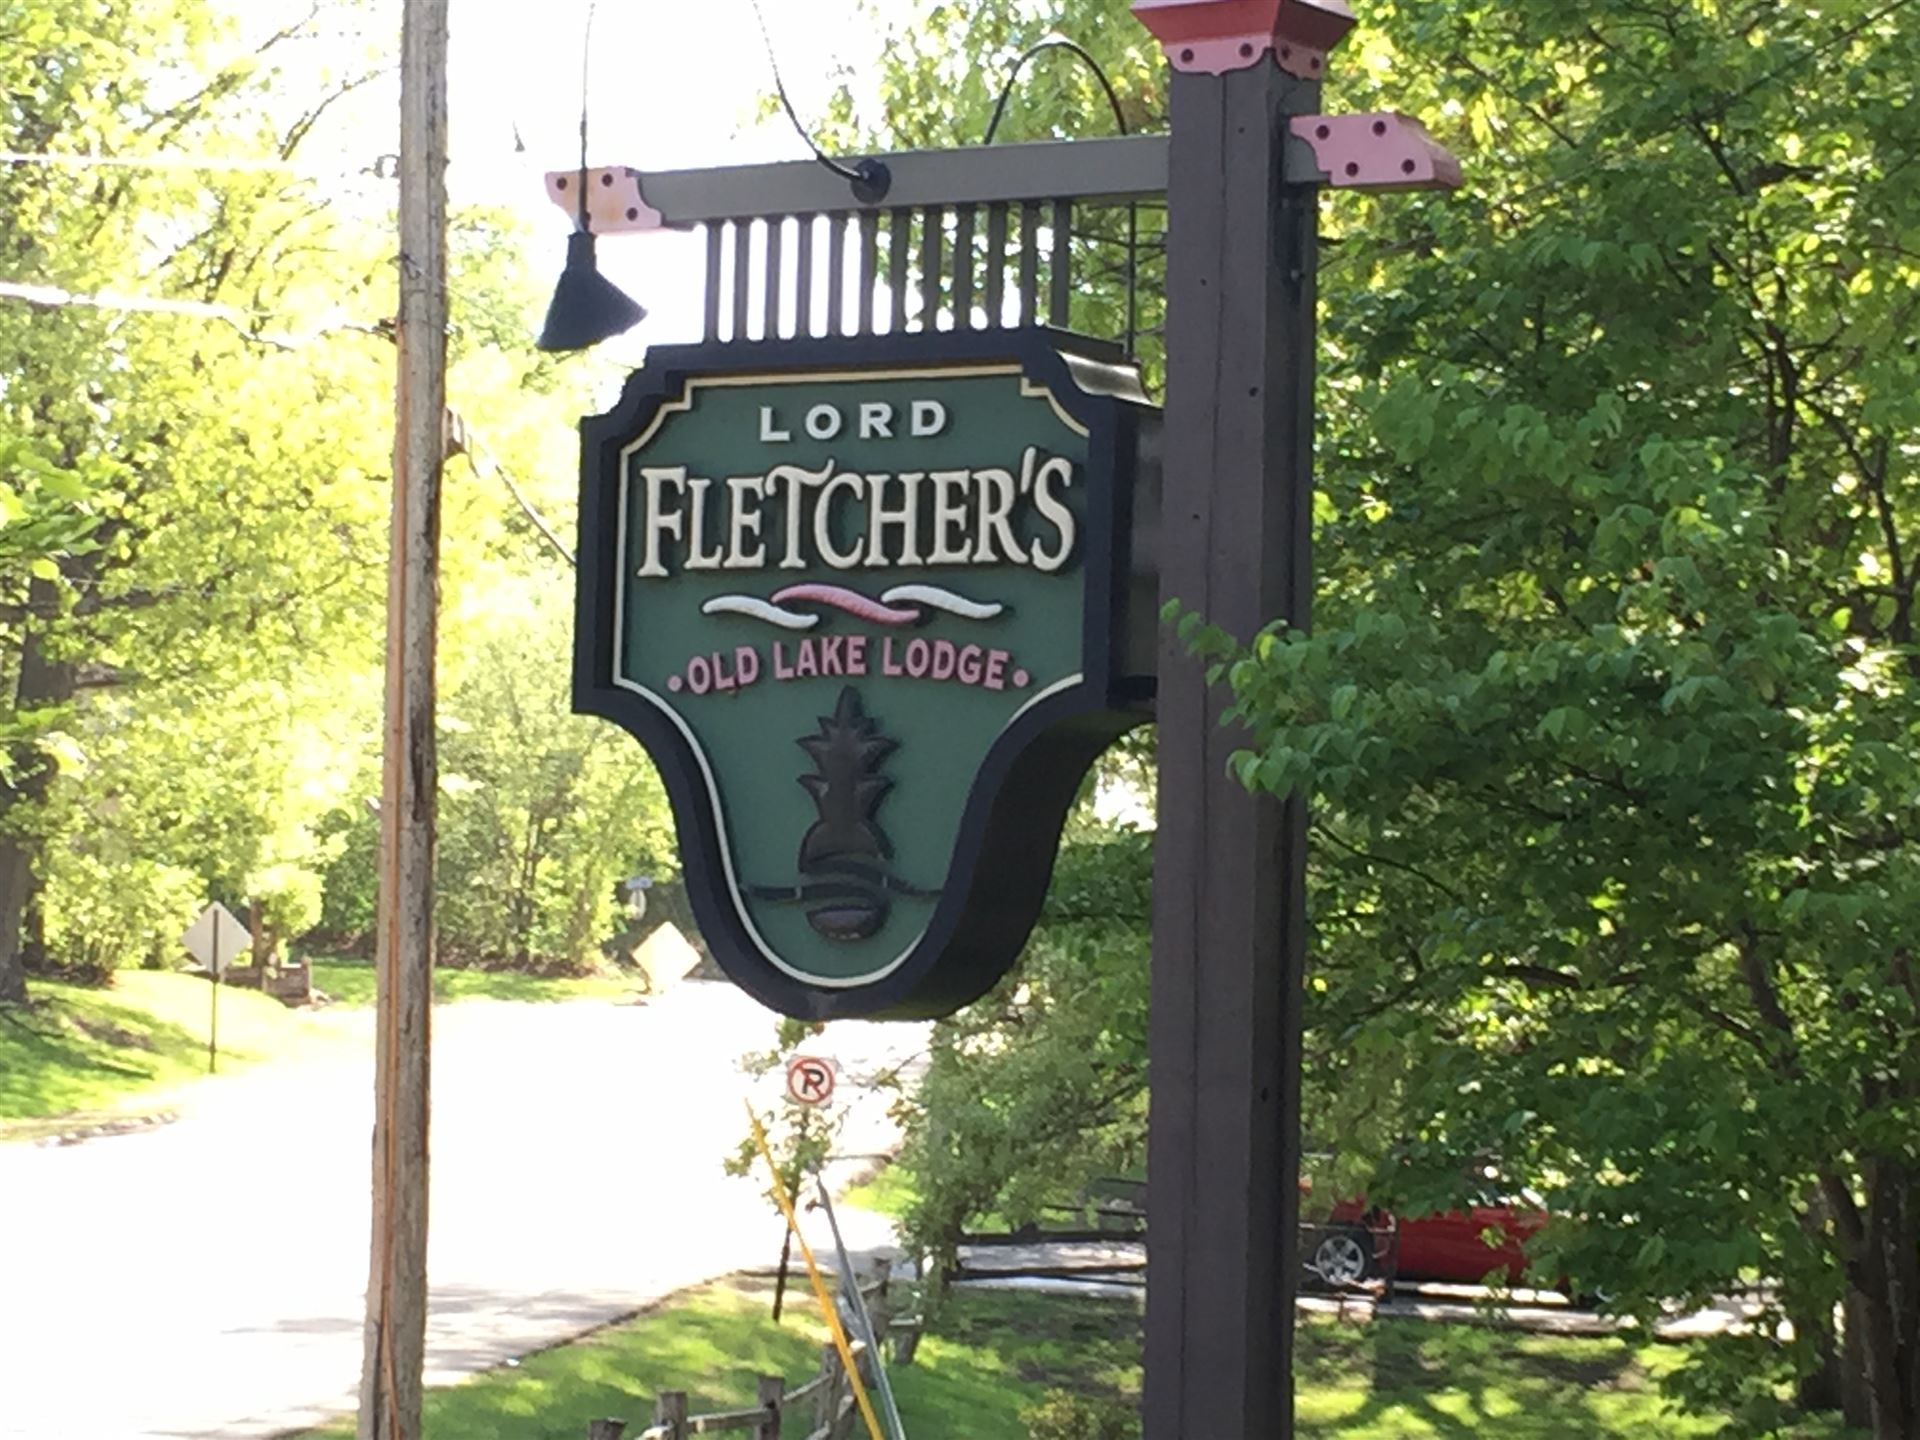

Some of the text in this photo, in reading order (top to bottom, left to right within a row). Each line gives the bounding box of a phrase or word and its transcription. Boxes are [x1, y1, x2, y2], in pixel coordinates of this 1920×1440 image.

[759, 400, 947, 442] LORD
[637, 446, 1076, 578] FLETCHER'S
[686, 635, 1010, 696] OLD LAKE LODGE
